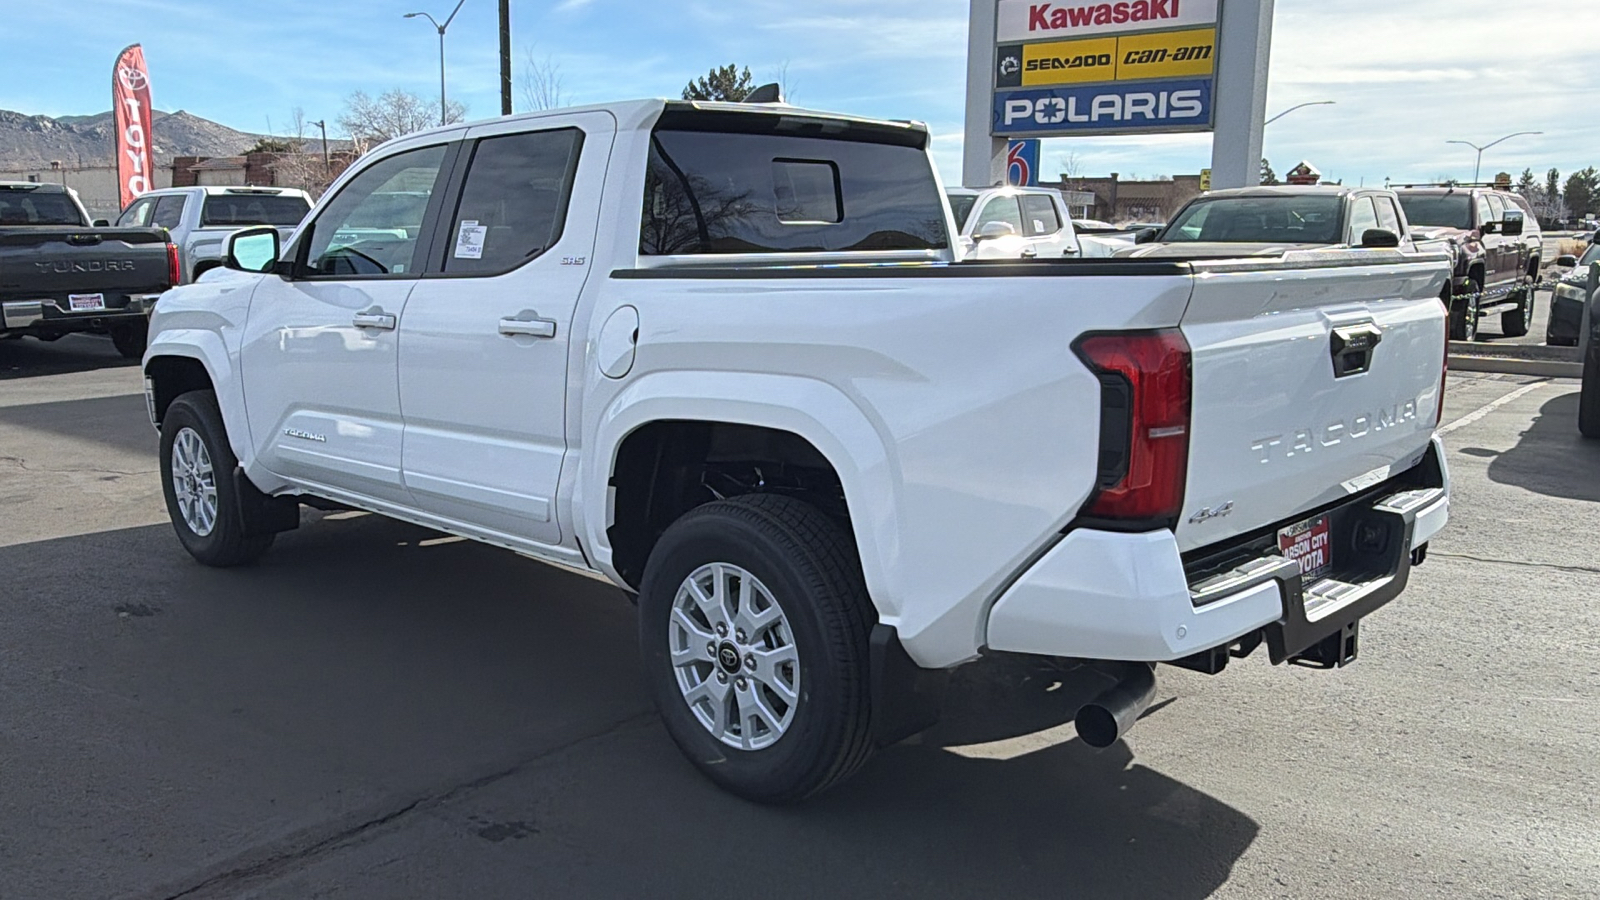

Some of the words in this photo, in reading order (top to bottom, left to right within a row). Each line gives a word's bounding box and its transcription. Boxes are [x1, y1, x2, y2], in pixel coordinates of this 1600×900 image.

[1029, 0, 1179, 31] Kawasaki
[1004, 90, 1203, 125] POLARIS
[125, 98, 148, 197] TOYO
[1008, 141, 1030, 186] 6
[35, 260, 136, 273] TUNDRA
[283, 428, 326, 443] TACOMA
[1251, 398, 1417, 464] TACOMA
[1311, 531, 1328, 549] CITY
[1297, 548, 1324, 574] YOTA
